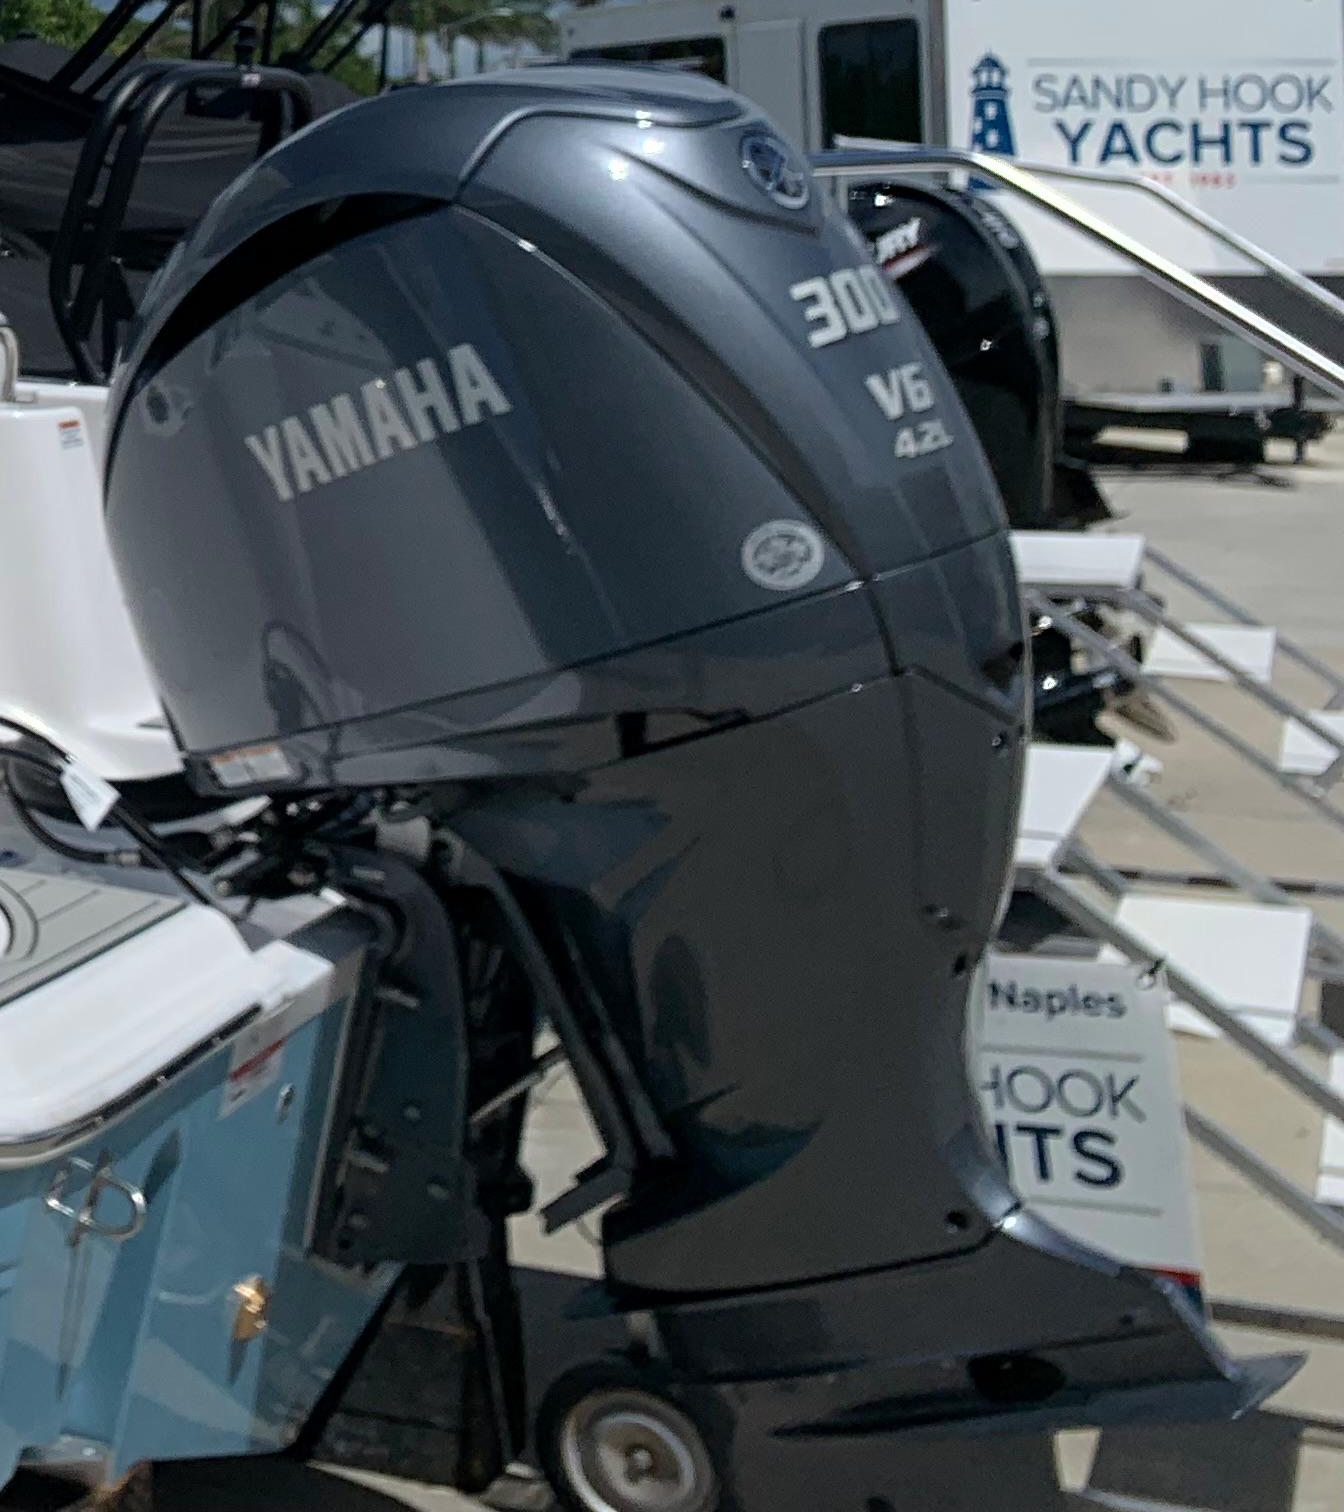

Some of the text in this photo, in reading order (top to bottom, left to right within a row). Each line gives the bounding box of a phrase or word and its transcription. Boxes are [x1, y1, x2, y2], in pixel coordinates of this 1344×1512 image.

[1032, 72, 1335, 114] SANDY HOOK
[1053, 118, 1314, 166] YACHTS
[790, 264, 901, 349] 300
[865, 361, 934, 420] V6
[244, 344, 512, 502] YAMAHA
[988, 981, 1128, 1020] Naples
